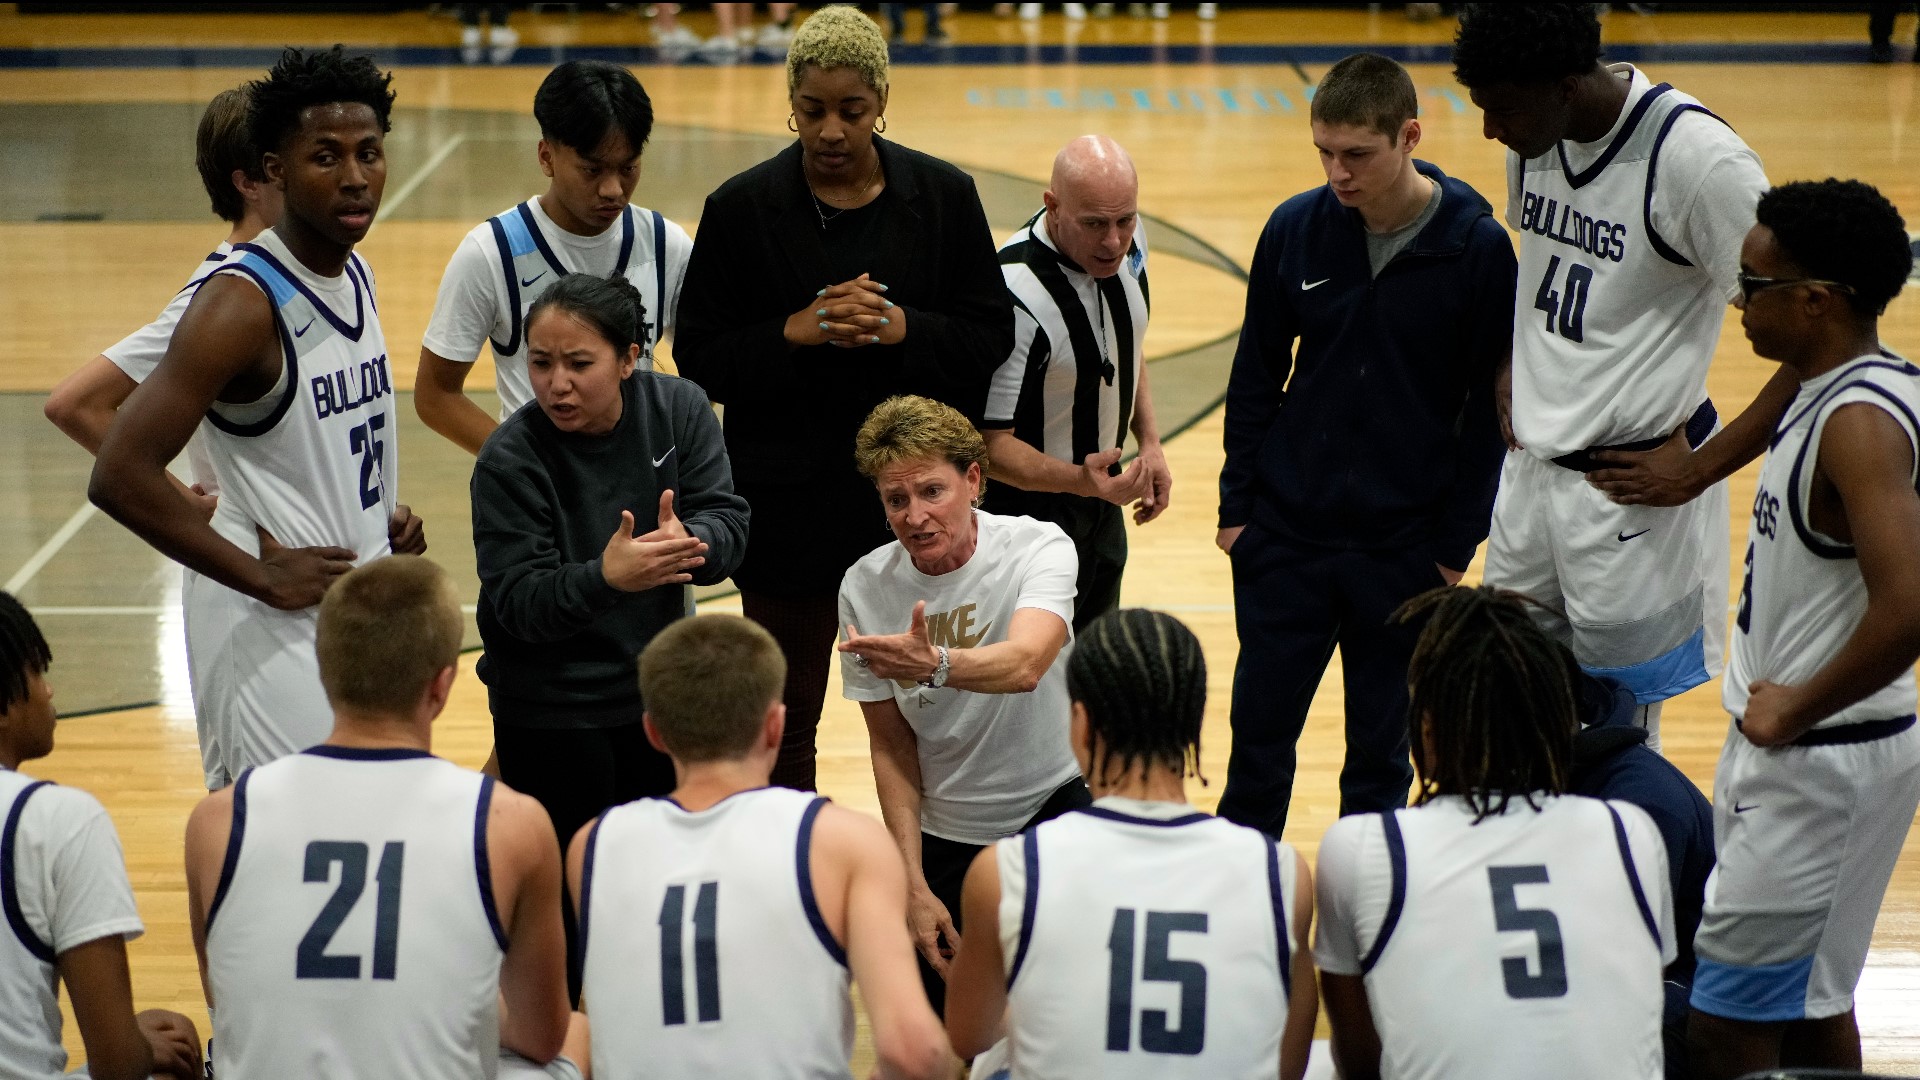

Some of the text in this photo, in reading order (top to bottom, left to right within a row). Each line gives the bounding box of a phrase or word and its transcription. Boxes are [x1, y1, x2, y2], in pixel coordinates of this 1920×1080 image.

[1521, 191, 1627, 263] BULLDOGS
[1534, 254, 1594, 344] 40
[311, 354, 391, 420] BULDO
[925, 602, 977, 648] IKE
[296, 840, 405, 980] 21
[658, 881, 721, 1026] 11
[1487, 865, 1568, 999] 5
[1106, 908, 1208, 1055] 15
